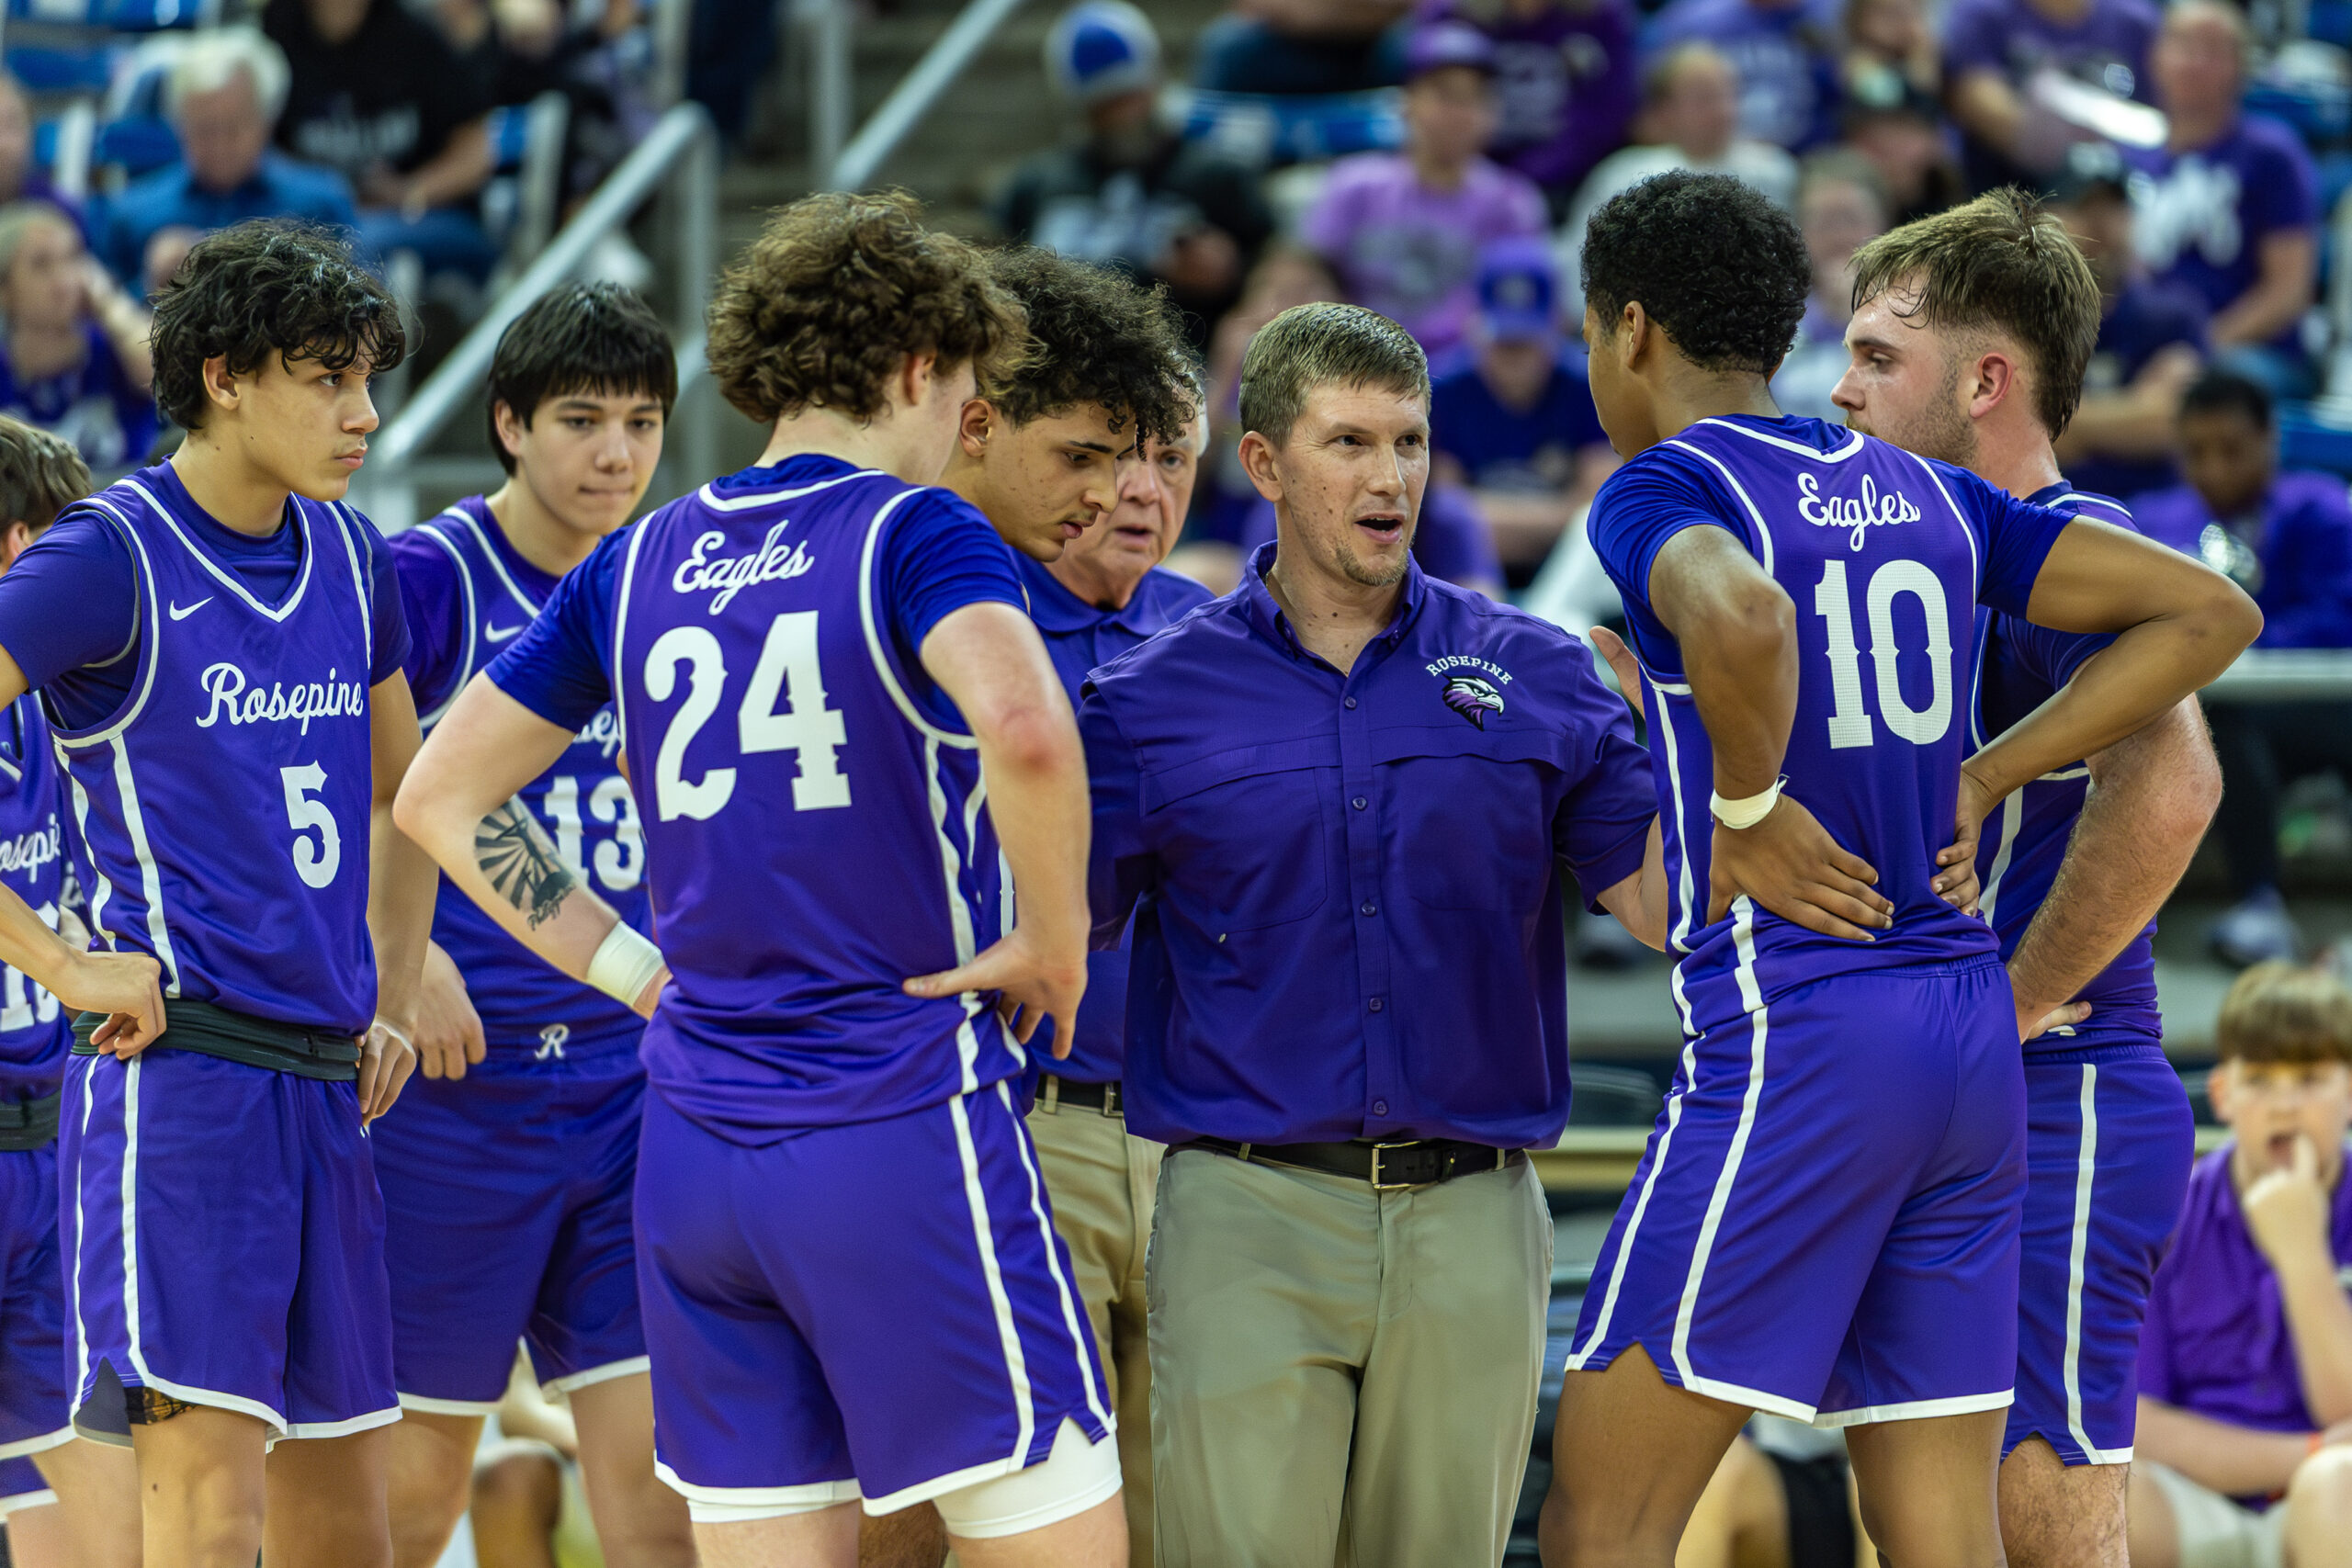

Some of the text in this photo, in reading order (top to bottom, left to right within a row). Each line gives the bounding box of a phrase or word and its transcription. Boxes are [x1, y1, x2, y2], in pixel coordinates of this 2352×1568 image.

[1797, 472, 1921, 551] Eagles
[673, 520, 814, 615] Eagles
[196, 662, 364, 736] Rosepine
[1425, 655, 1513, 685] ROSEPINE
[1815, 559, 1953, 750] 10
[644, 610, 852, 822] 24
[279, 760, 341, 888] 5
[544, 776, 645, 891] 13
[535, 1022, 570, 1060] R
